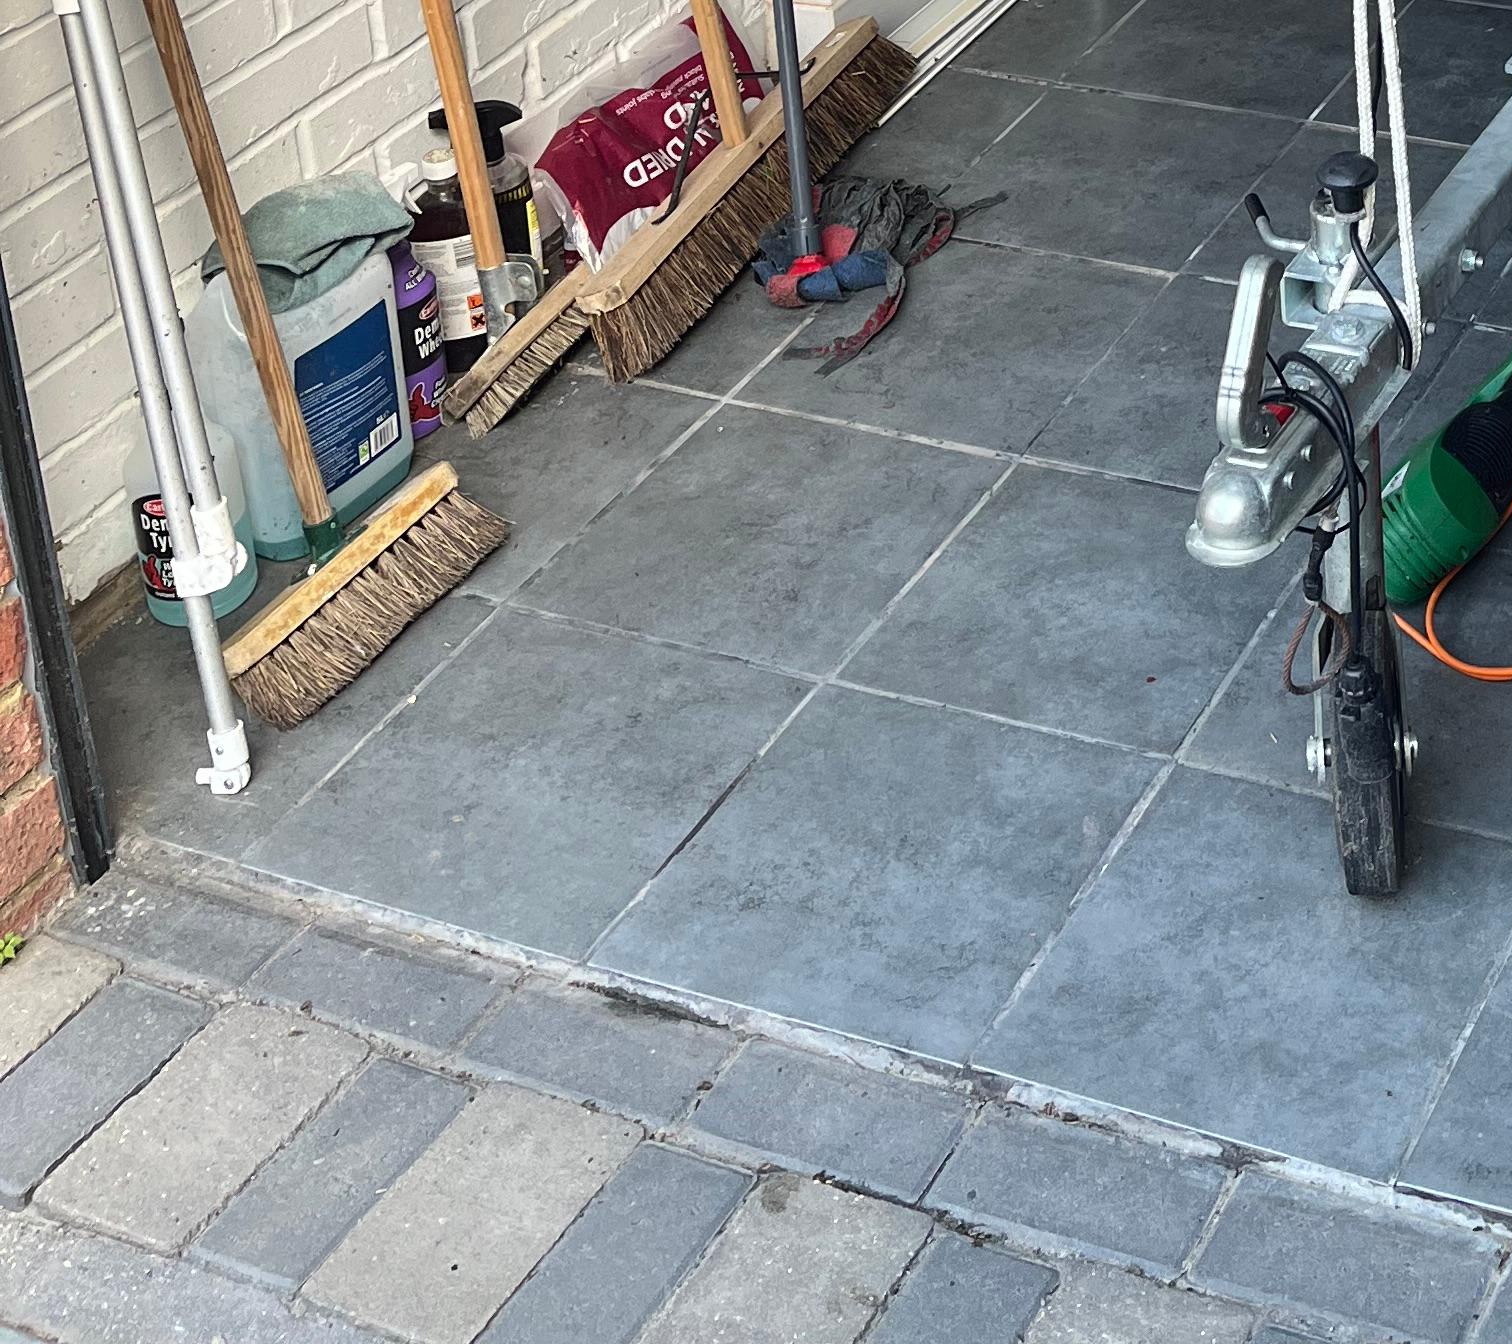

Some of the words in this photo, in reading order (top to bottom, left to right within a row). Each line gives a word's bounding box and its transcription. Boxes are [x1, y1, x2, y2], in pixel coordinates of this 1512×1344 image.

[623, 136, 687, 188] DRIED
[414, 319, 441, 346] Dem
[149, 532, 173, 553] Ty
